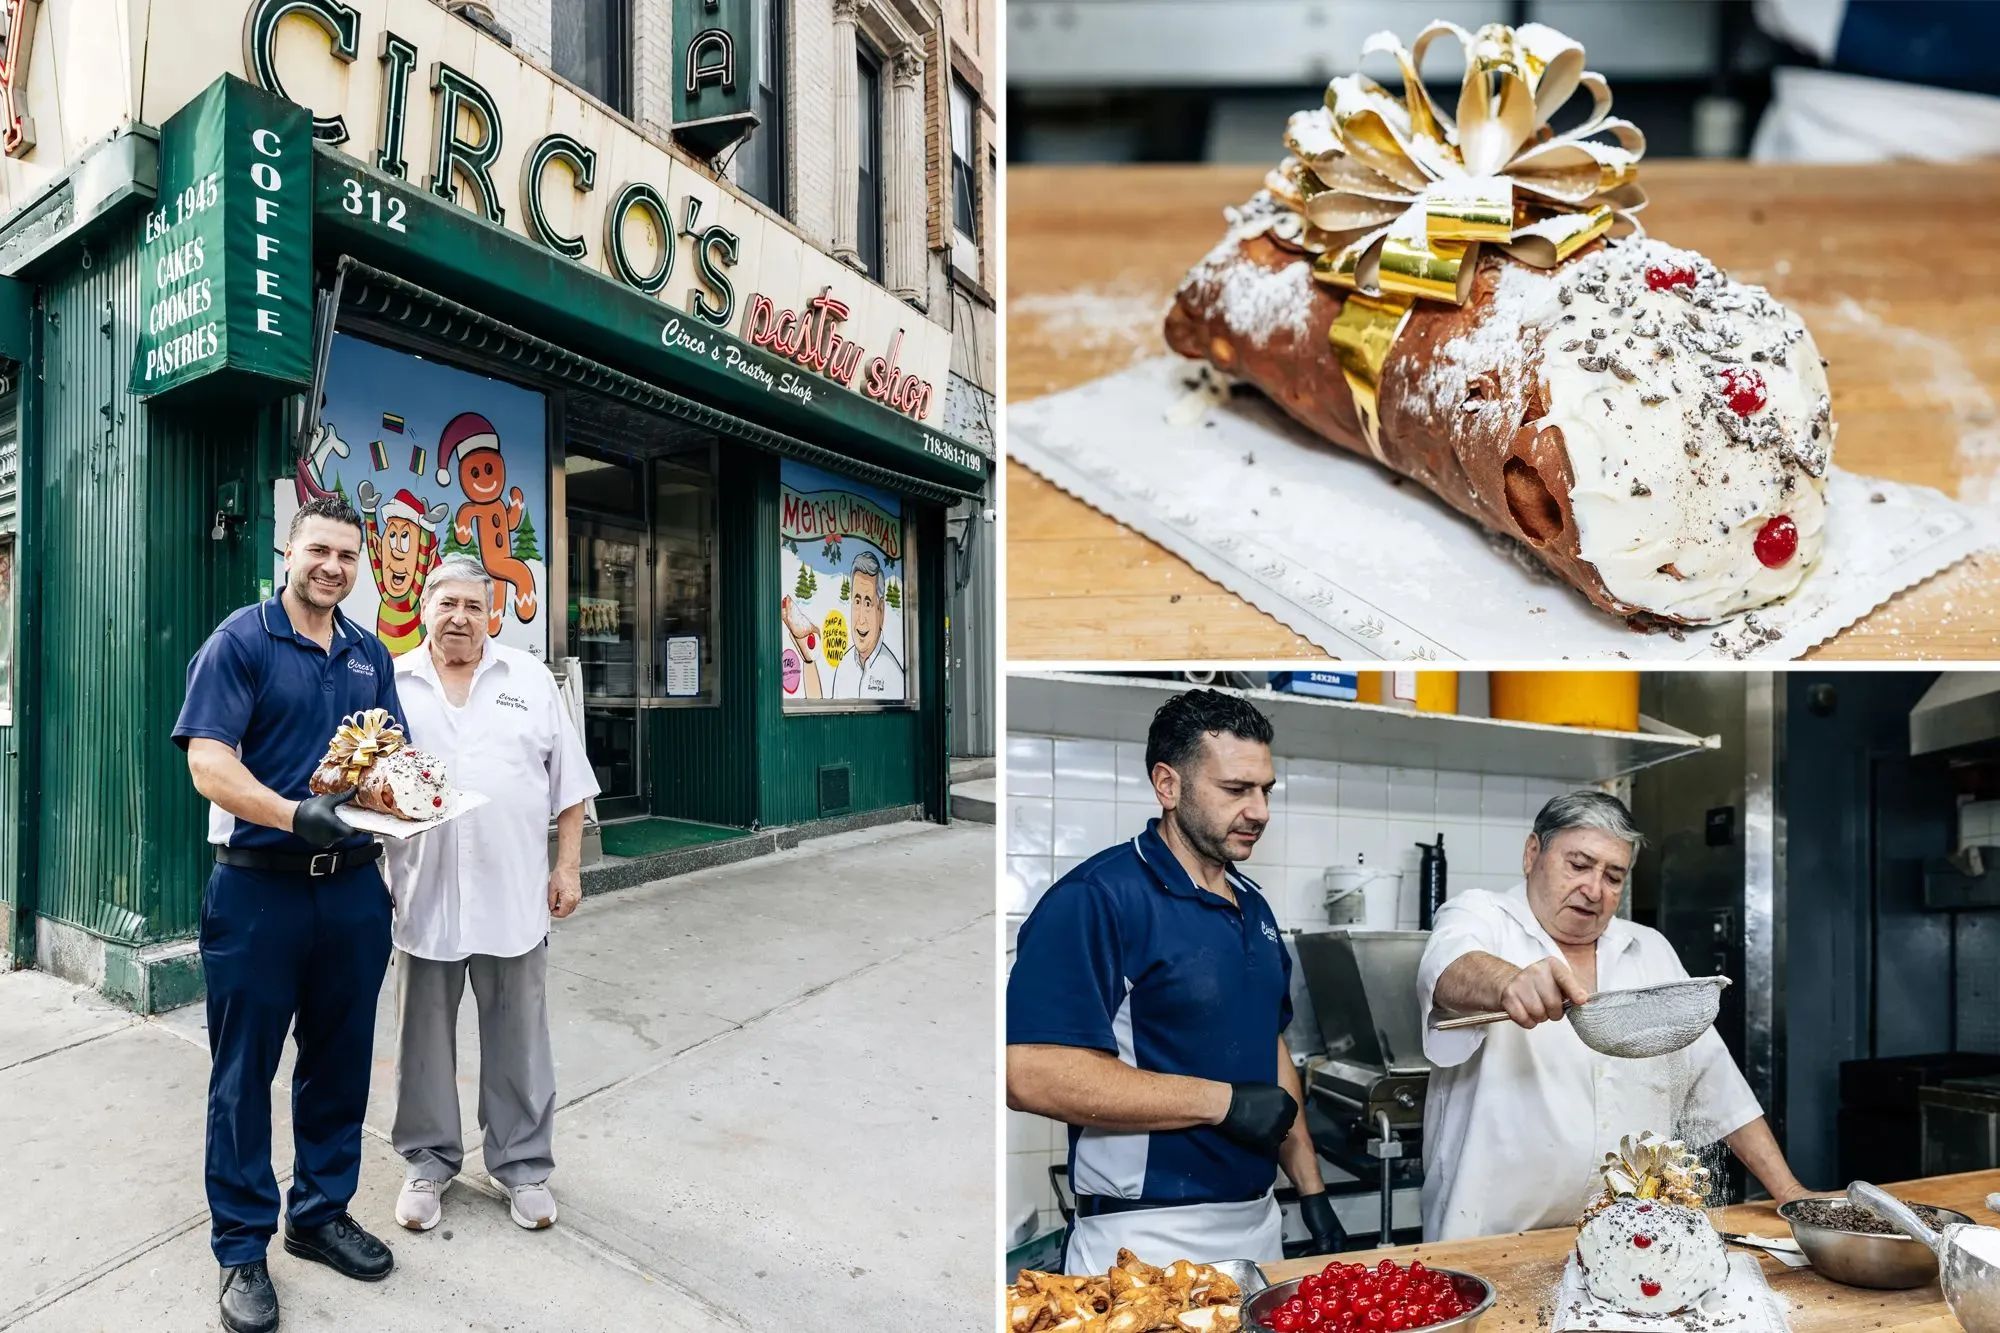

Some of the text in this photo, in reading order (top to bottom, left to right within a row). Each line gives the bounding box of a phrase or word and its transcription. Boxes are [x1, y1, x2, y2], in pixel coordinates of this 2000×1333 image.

[243, 0, 740, 328] CIRCO'S
[145, 172, 218, 244] Est. 1945
[251, 129, 282, 336] COFFEE
[342, 178, 407, 233] 312
[156, 236, 204, 289] CAKES
[149, 277, 212, 335] COOKIES
[145, 321, 218, 380] PASTRIES
[661, 318, 812, 406] Circo's Pastry Shop
[745, 286, 934, 420] pastry shop
[922, 433, 981, 471] 718-381-7199
[782, 493, 837, 535] Merry
[347, 658, 375, 673] Circo's
[826, 650, 843, 661] NINO
[1310, 672, 1341, 685] 24X2M
